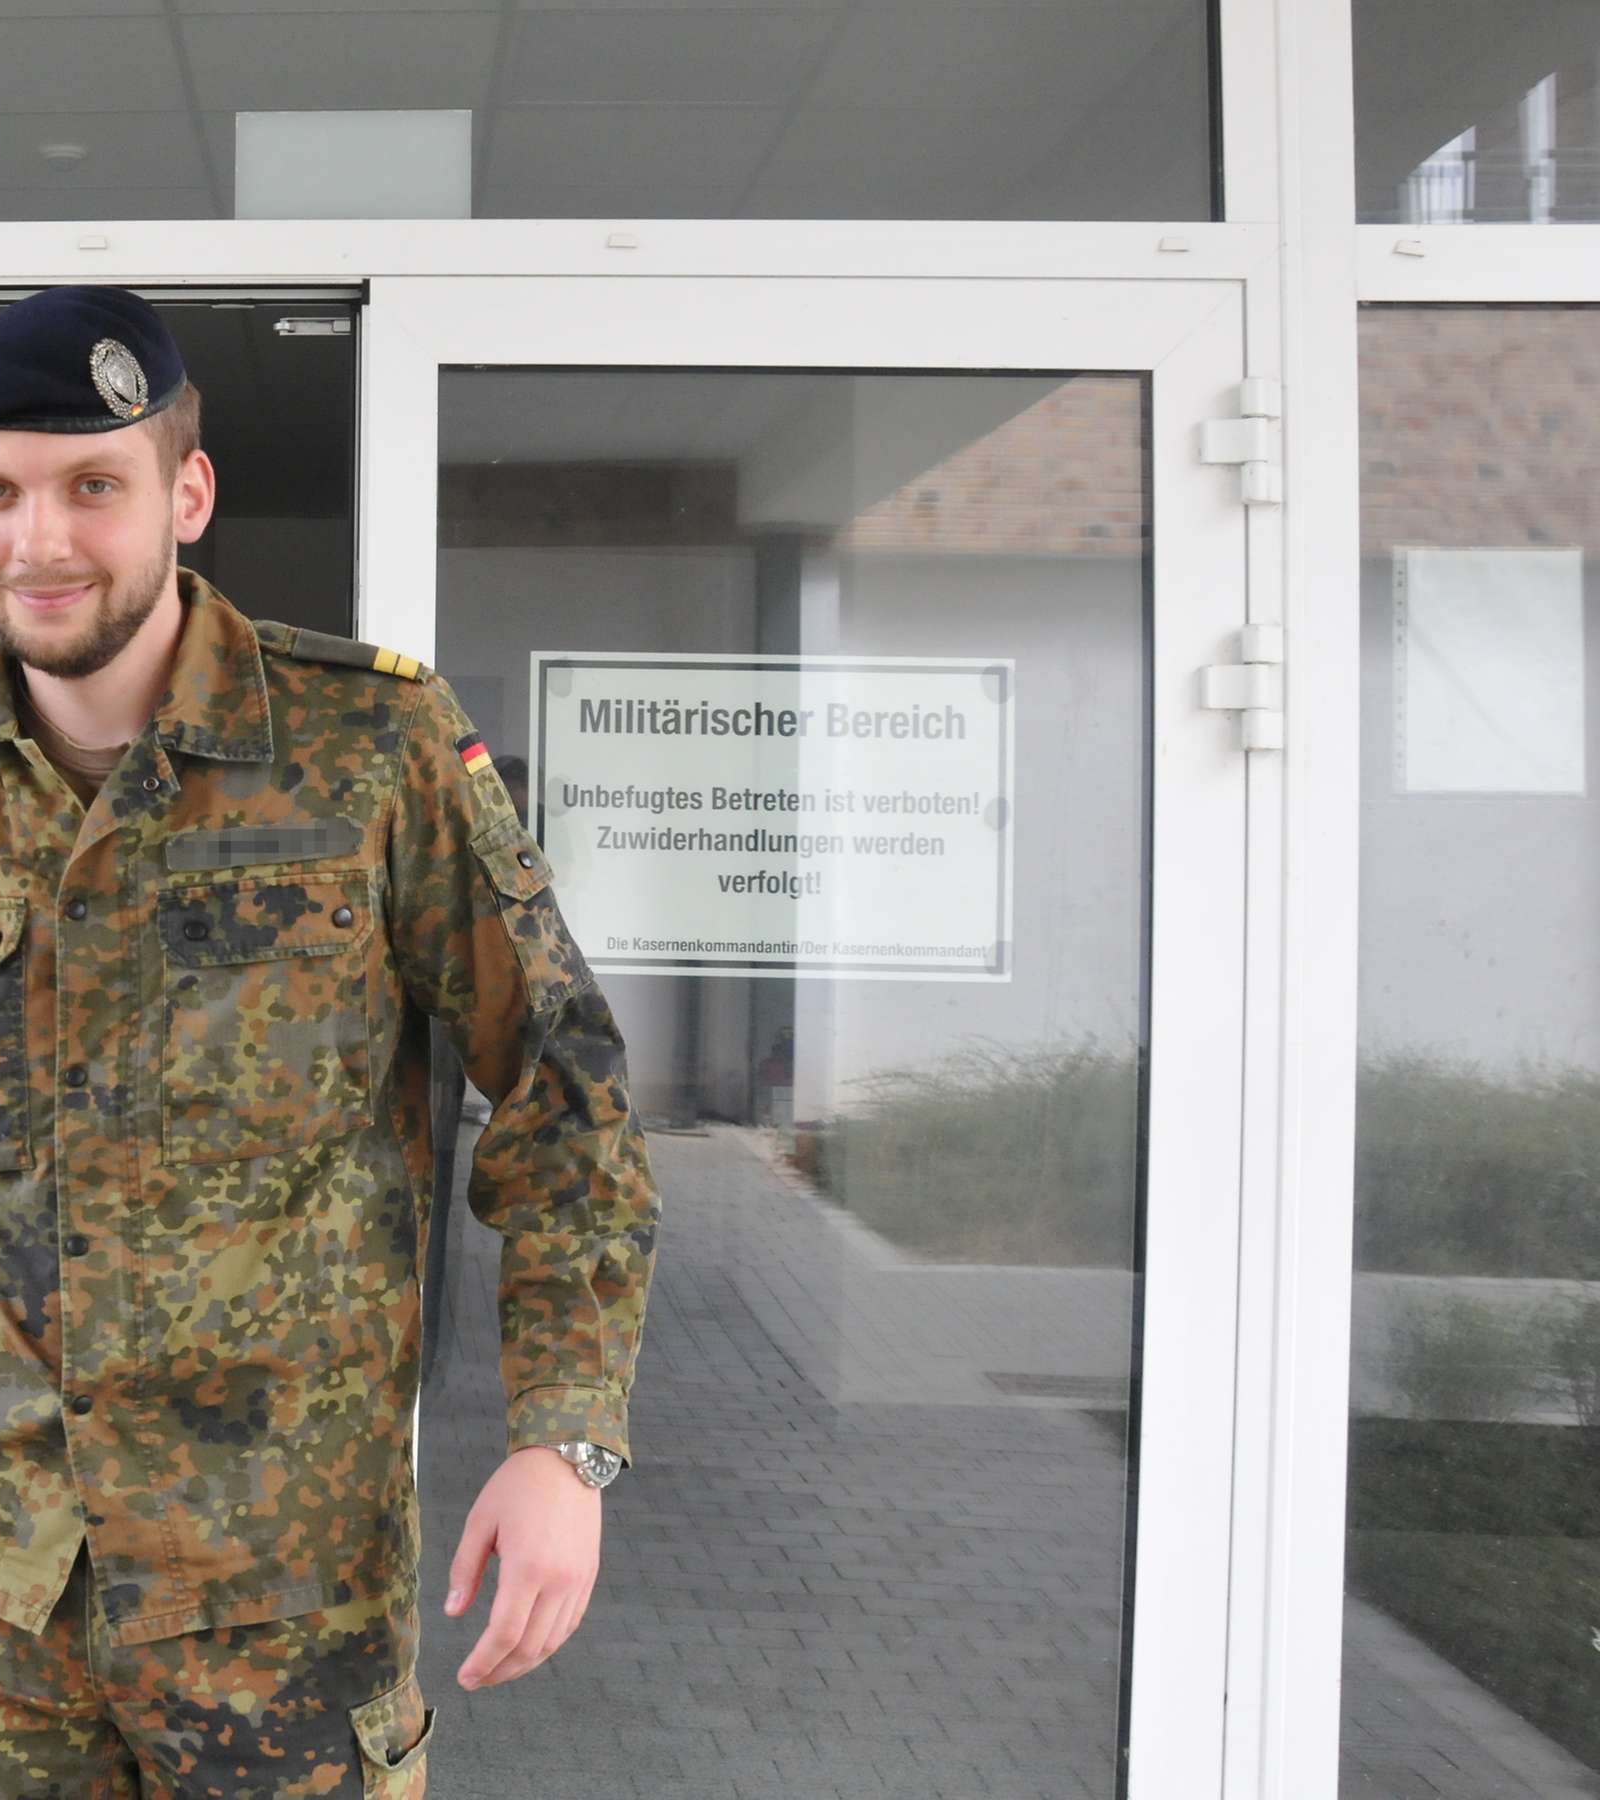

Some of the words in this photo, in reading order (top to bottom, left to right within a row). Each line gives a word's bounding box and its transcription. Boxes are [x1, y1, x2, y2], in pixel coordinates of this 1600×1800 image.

[579, 698, 814, 737] Militärischer
[826, 702, 967, 740] Bereich
[563, 784, 703, 815] Unbefugtes
[711, 786, 816, 812] Betreten
[825, 788, 855, 812] ist
[863, 789, 980, 816] verboten!
[597, 826, 843, 859] Zuwiderhandlungen
[853, 831, 945, 856] werden
[718, 870, 821, 900] verfolgt!
[607, 937, 628, 951] Die
[633, 937, 828, 956] Kasernenkommandantin/Der
[832, 942, 987, 959] Kasernenkommandant
